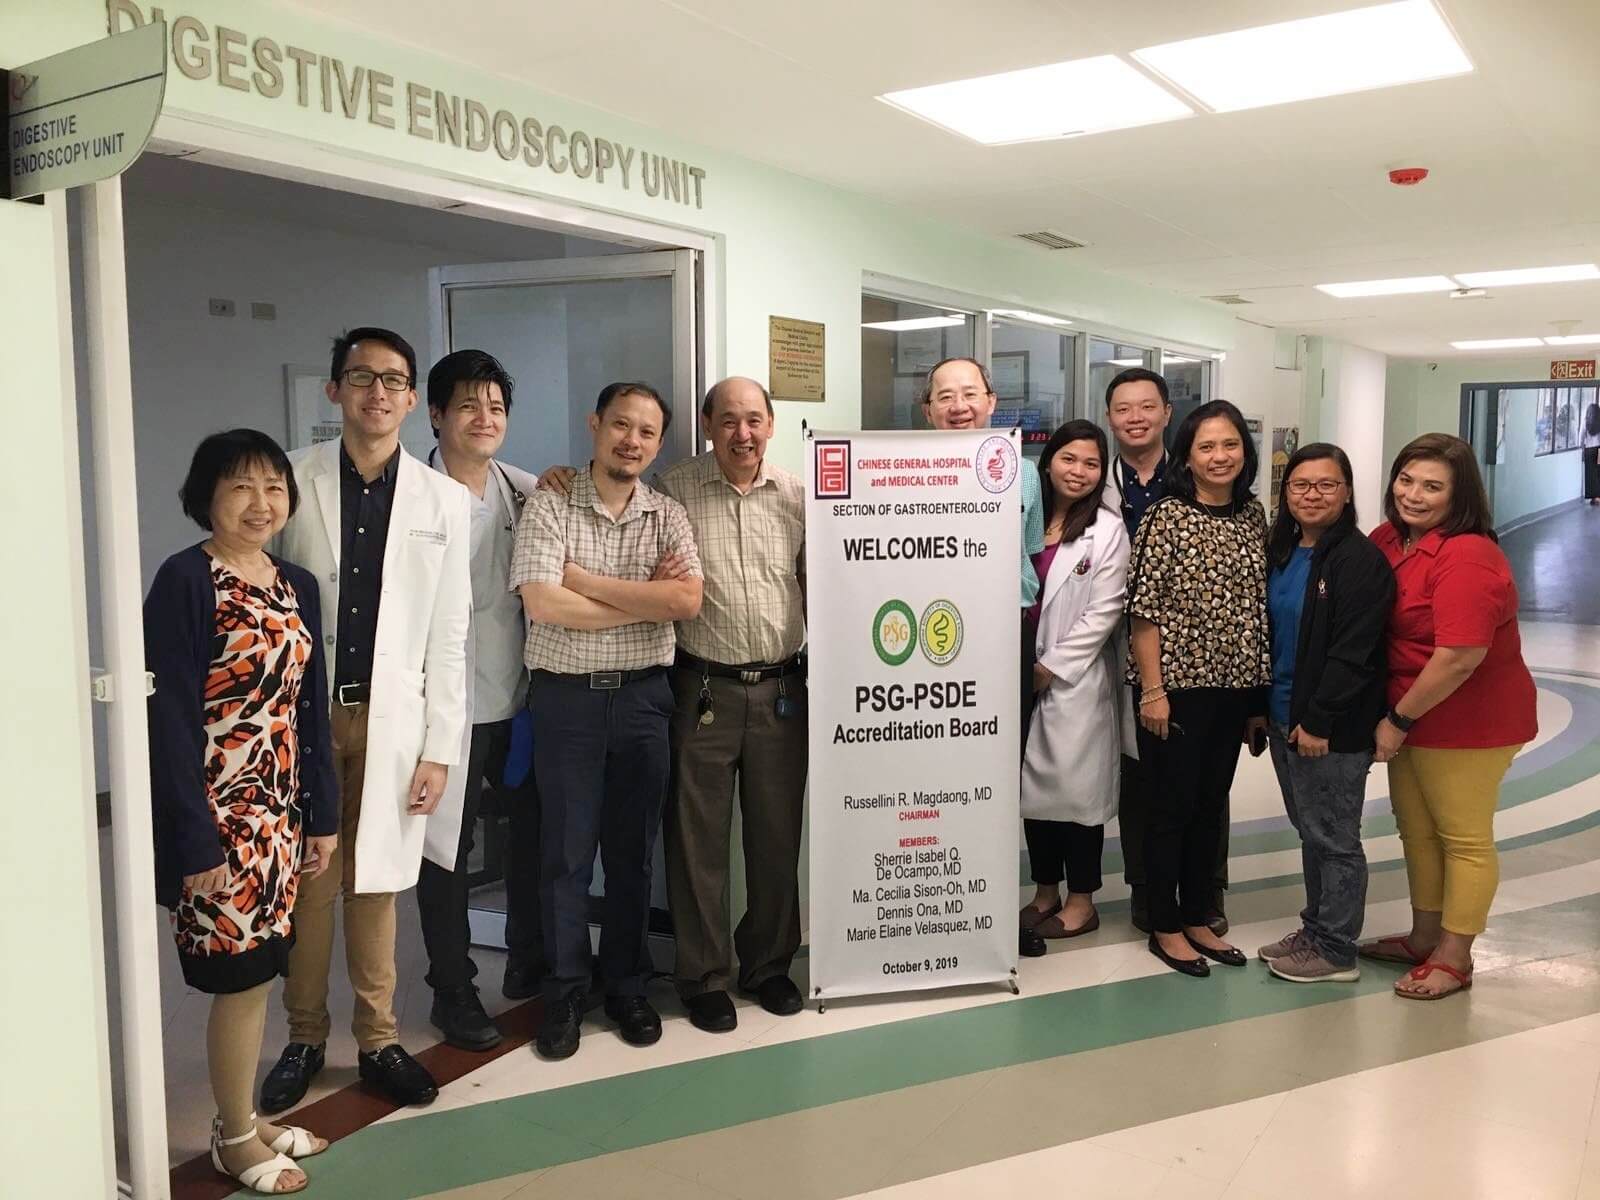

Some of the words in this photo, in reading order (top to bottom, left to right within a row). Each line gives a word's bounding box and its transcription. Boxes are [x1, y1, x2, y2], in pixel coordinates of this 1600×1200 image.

[105, 0, 396, 129] DGESTIVE
[407, 81, 635, 190] ENDOSCOPY
[641, 151, 707, 210] UNIT
[13, 115, 77, 149] DIGESTIVE
[14, 140, 90, 176] ENDOSCOPY
[93, 132, 125, 158] UNIT
[1569, 363, 1593, 378] Exit
[857, 458, 892, 470] CHINESE
[893, 458, 931, 470] GENERAL
[932, 457, 972, 469] HOSPITAL
[870, 476, 887, 487] and
[888, 475, 926, 487] MEDICAL
[927, 475, 959, 486] CENTER
[833, 504, 876, 516] SECTION
[878, 504, 892, 516] OF
[894, 502, 1001, 515] GASTROENTEROLOGY
[843, 536, 958, 561] WELCOMES
[963, 538, 988, 558] the
[883, 623, 908, 642] PSG
[856, 680, 977, 713] PSG-PSDE
[833, 720, 944, 744] Accreditation
[950, 715, 998, 738] Board
[844, 793, 896, 810] Russellini
[898, 793, 910, 807] R.
[913, 789, 971, 808] Magdaong,
[974, 786, 993, 801] MD
[898, 810, 940, 821] CHAIRMAN
[899, 836, 940, 848] MEMBERS:
[874, 852, 912, 867] Sherrie
[915, 848, 947, 863] Isabel
[949, 847, 962, 861] Q.
[876, 866, 892, 881] De
[894, 863, 942, 881] Ocampo,
[943, 861, 962, 876] MD
[852, 889, 873, 904] Ma.
[876, 885, 911, 901] Cecilia
[913, 881, 966, 898] Sison-Oh,
[968, 878, 987, 893] MD
[877, 904, 913, 921] Dennis
[916, 902, 941, 917] Ona,
[945, 899, 964, 915] MD
[847, 926, 877, 942] Marie
[879, 923, 912, 939] Elaine
[915, 919, 972, 936] Velasquez,
[974, 915, 993, 931] MD
[883, 960, 922, 975] October
[924, 959, 933, 972] 9,
[936, 956, 959, 971] 2019
